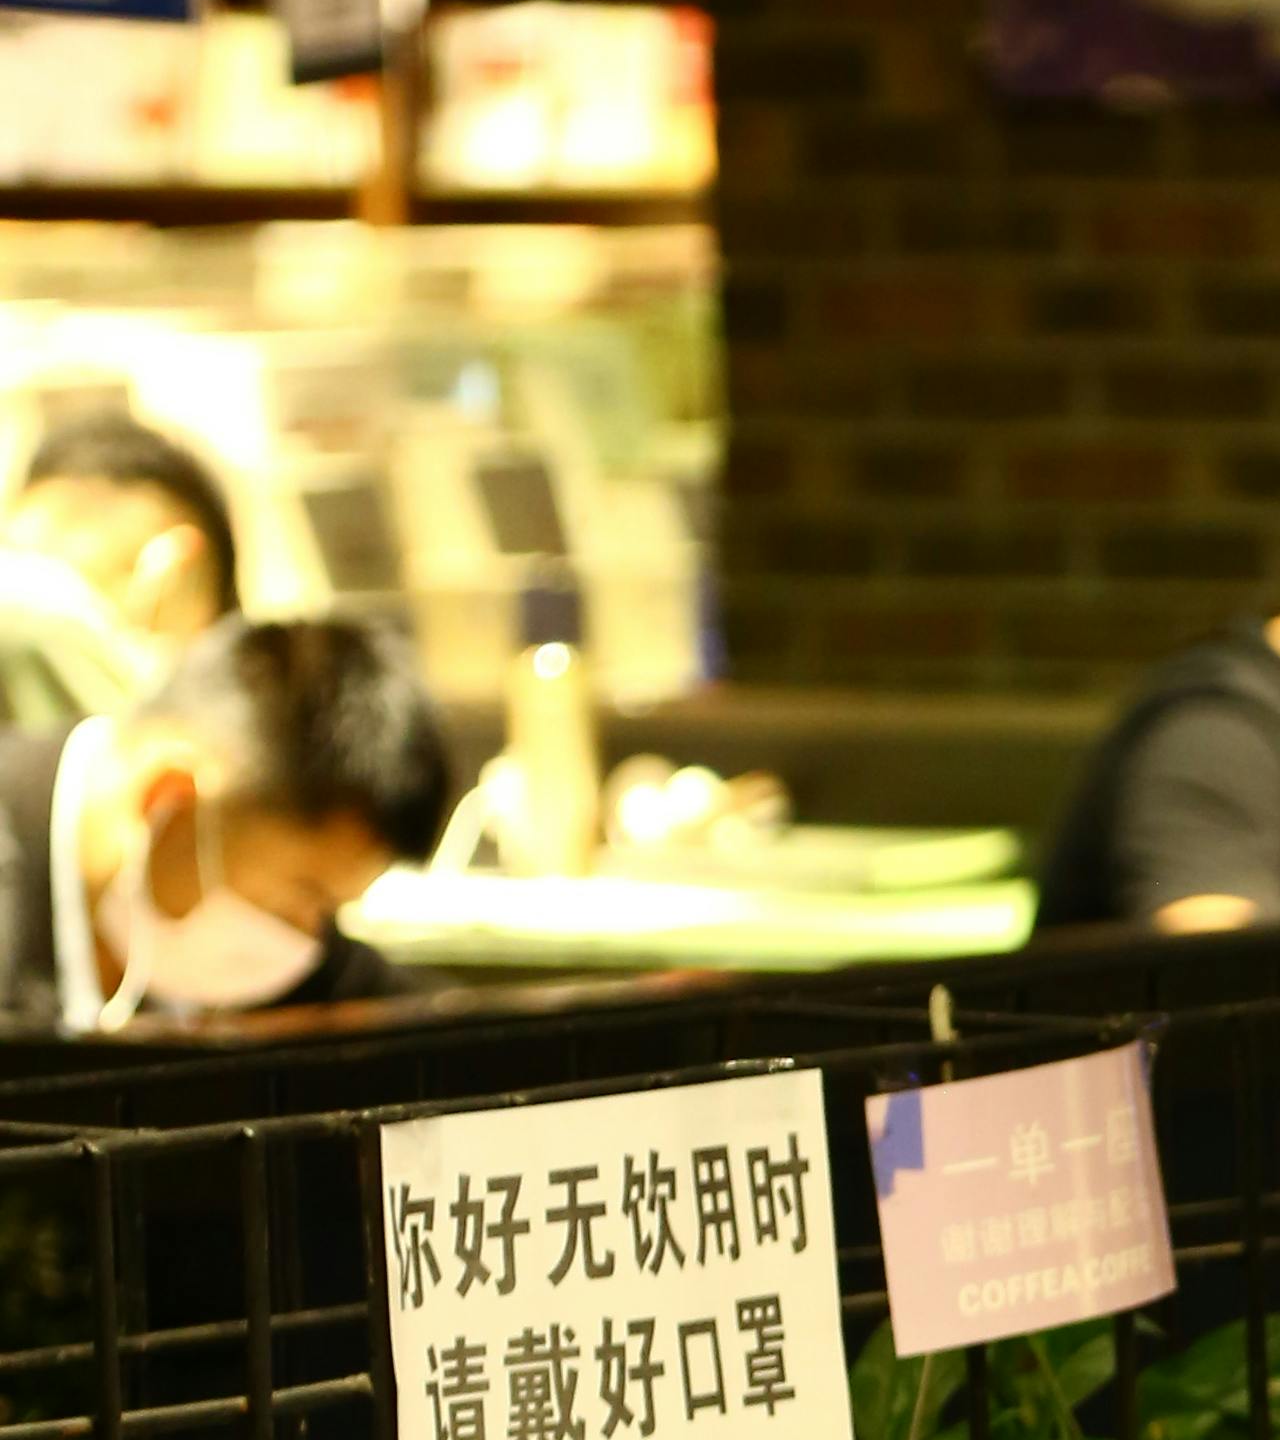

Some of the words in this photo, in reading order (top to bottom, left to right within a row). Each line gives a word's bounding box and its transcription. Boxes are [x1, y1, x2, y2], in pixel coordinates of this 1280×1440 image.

[389, 1132, 810, 1311] 你好无饮用时
[958, 1264, 1080, 1318] COFFEA
